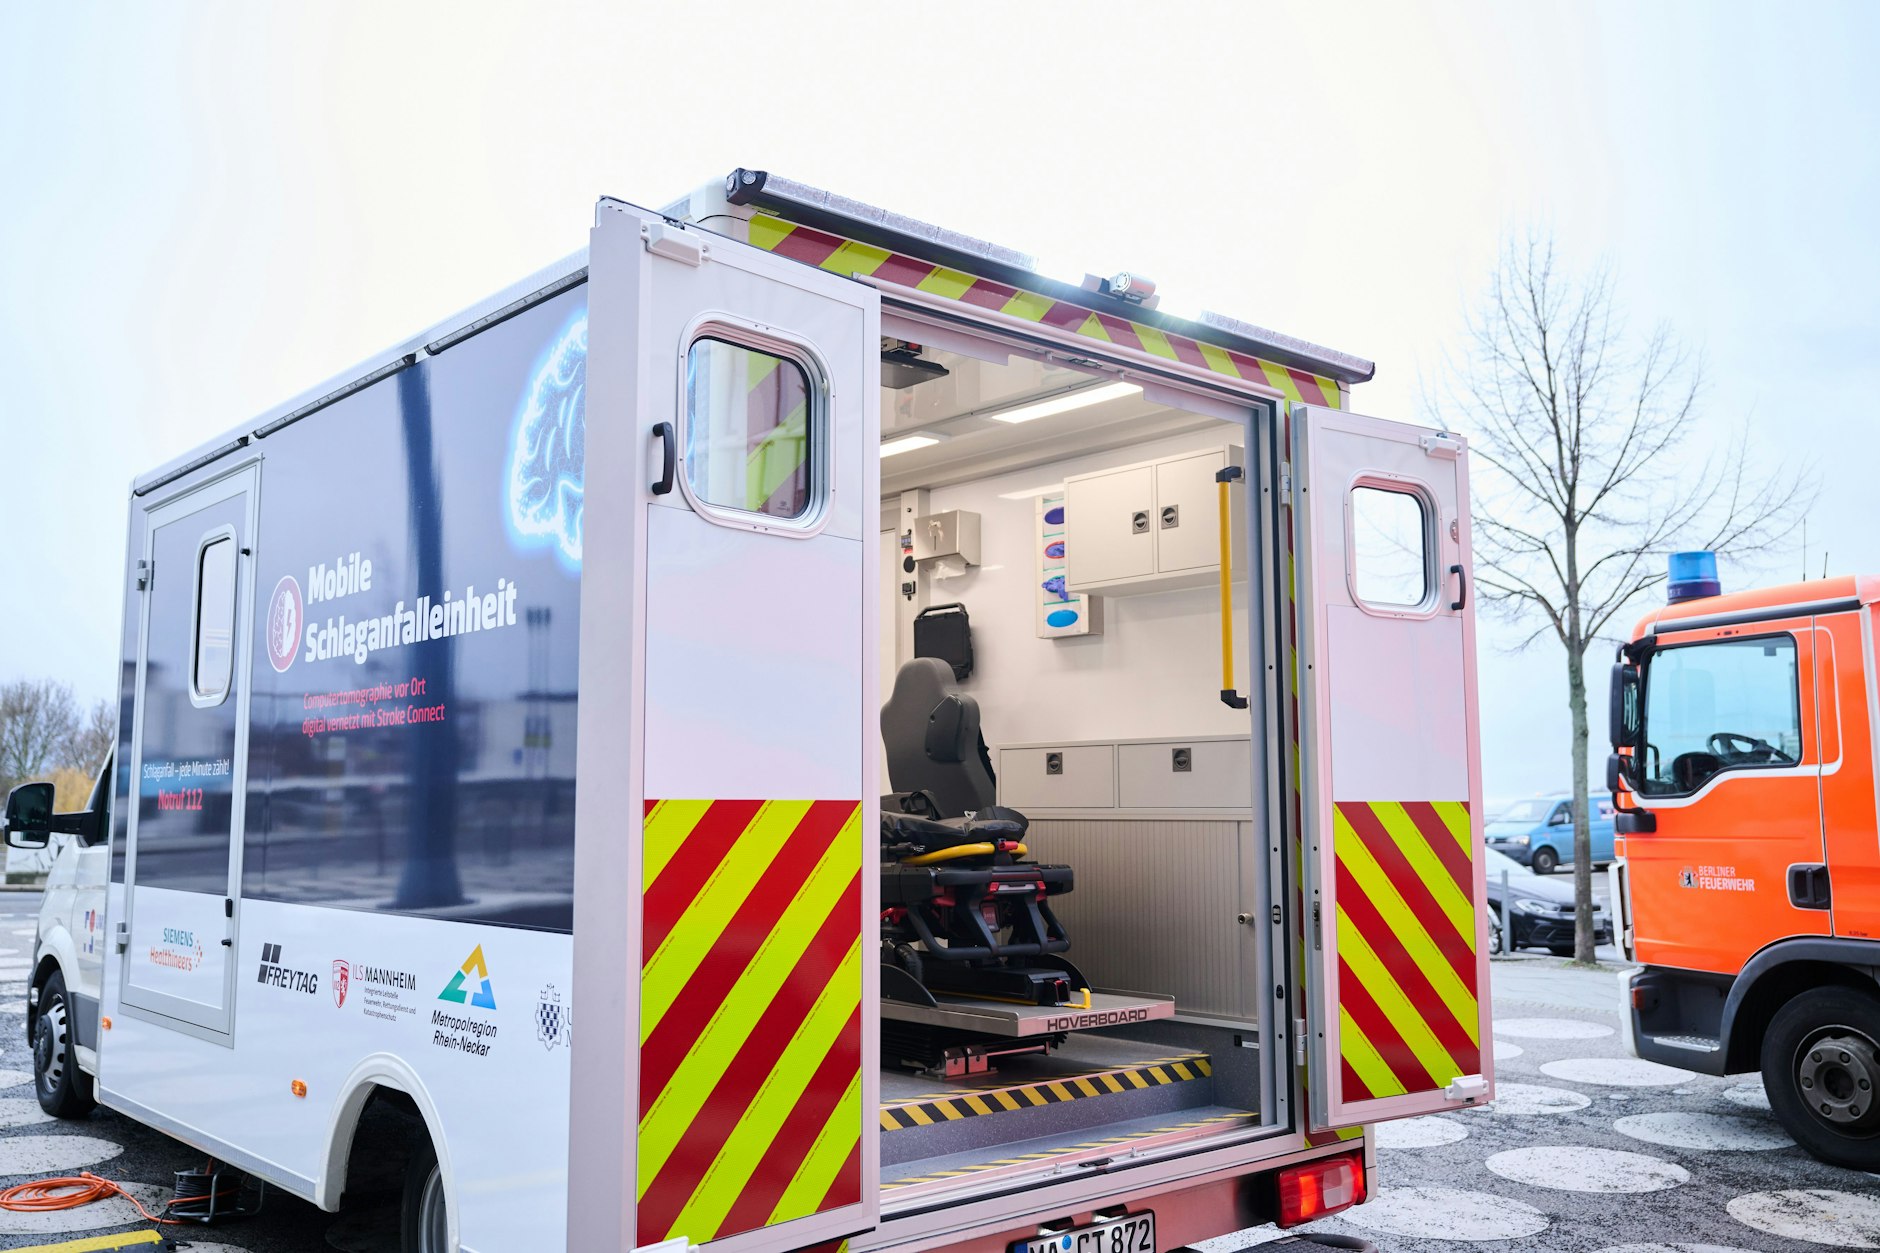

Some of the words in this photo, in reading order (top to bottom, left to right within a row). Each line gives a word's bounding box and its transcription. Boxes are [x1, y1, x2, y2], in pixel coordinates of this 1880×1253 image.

[307, 552, 372, 604] Mobile
[305, 577, 517, 664] Schlaganfalleinheit
[303, 682, 393, 710] Computertomographie
[394, 683, 409, 698] vor
[411, 677, 426, 696] Ort
[302, 715, 326, 737] digital
[326, 713, 360, 731] vernetzt
[361, 710, 376, 728] mit
[377, 706, 405, 727] Stroke
[407, 703, 445, 724] Connect
[143, 762, 175, 782] Schlaganfall
[179, 761, 192, 781] jede
[192, 760, 212, 776] Minute
[158, 787, 185, 810] Notruf
[186, 788, 203, 810] 112
[1698, 866, 1736, 877] BERLINER
[1700, 877, 1755, 891] FEUERWEHR
[163, 927, 194, 947] SIEMENS
[150, 946, 192, 971] Healthineers
[266, 965, 318, 994] FREYTAG
[352, 964, 364, 980] ILS
[365, 966, 416, 991] MANNHEIM
[431, 1010, 497, 1038] Metropolregion
[1047, 1009, 1147, 1031] HOVERBOARD
[433, 1030, 490, 1056] Rhein-Neckar
[1112, 1219, 1151, 1253] 872
